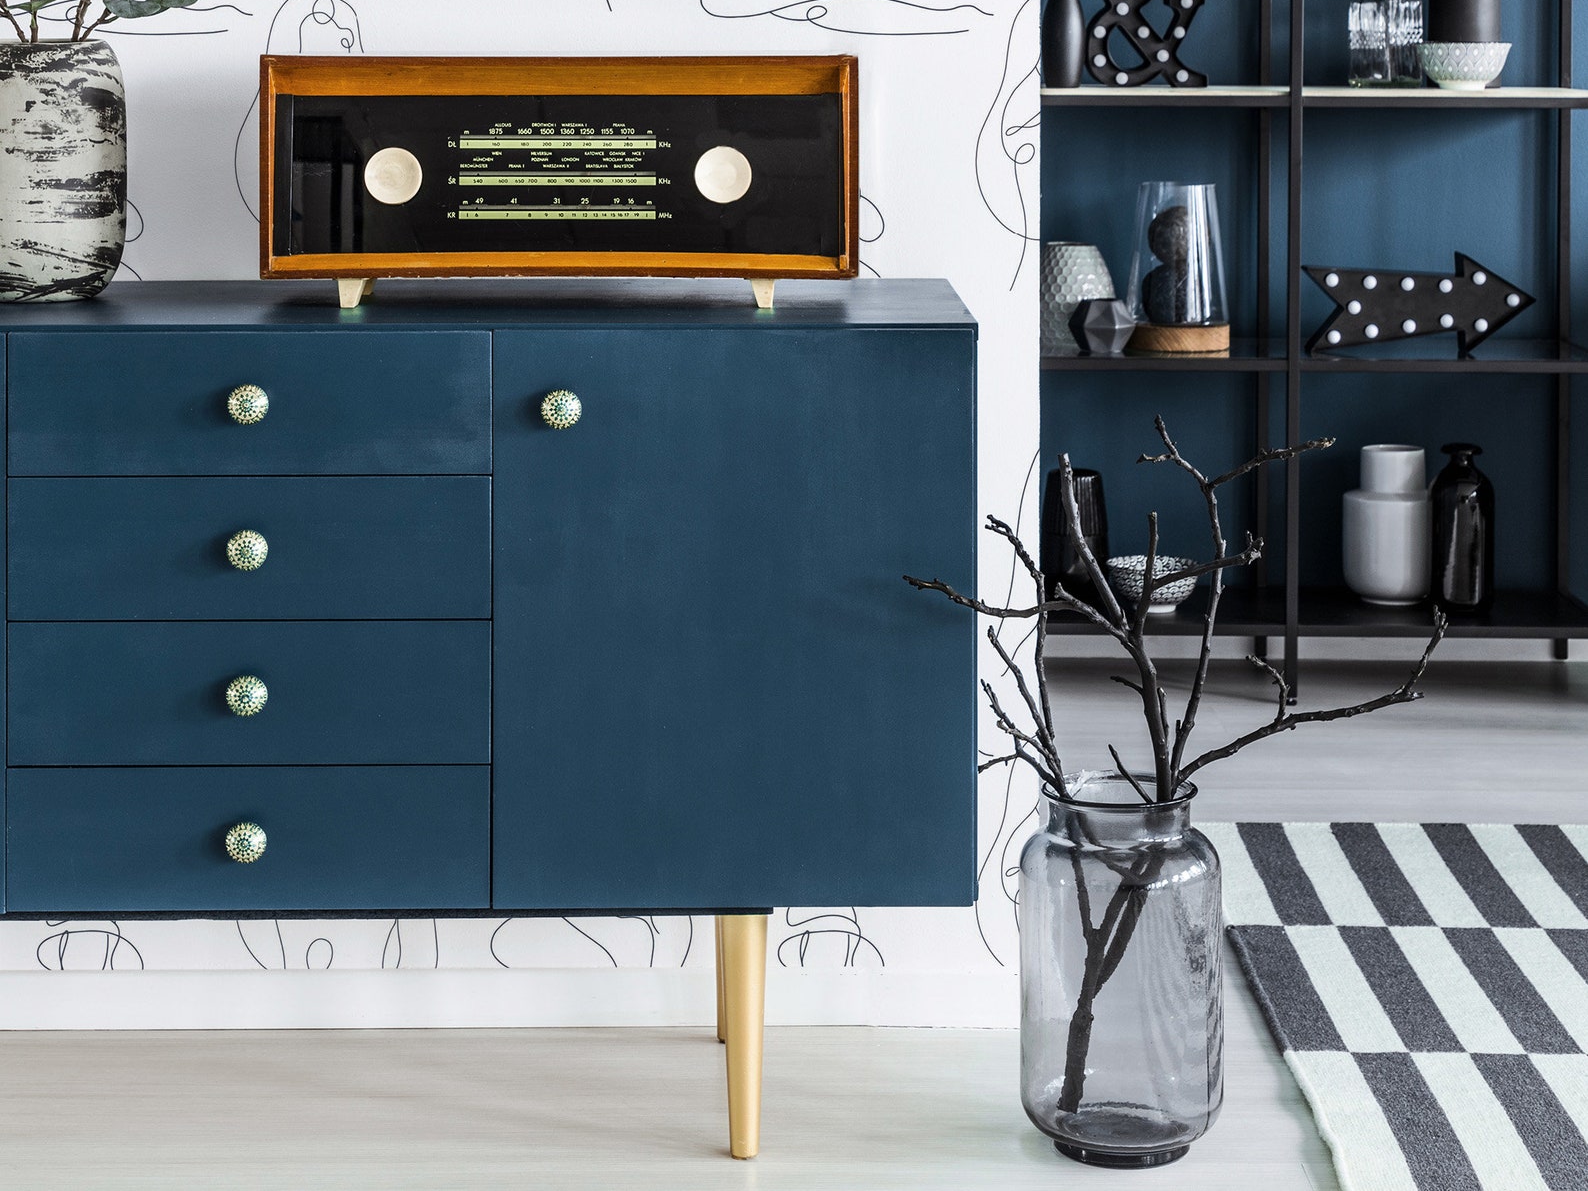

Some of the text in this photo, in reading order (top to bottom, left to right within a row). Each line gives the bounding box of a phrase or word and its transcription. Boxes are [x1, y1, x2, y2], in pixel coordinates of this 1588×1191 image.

[488, 127, 504, 135] 1875
[517, 127, 533, 135] 1660
[539, 127, 555, 135] 1500
[560, 127, 575, 135] 1360
[579, 127, 595, 135] 1250
[600, 127, 614, 135] 1155
[620, 127, 636, 135] 1070
